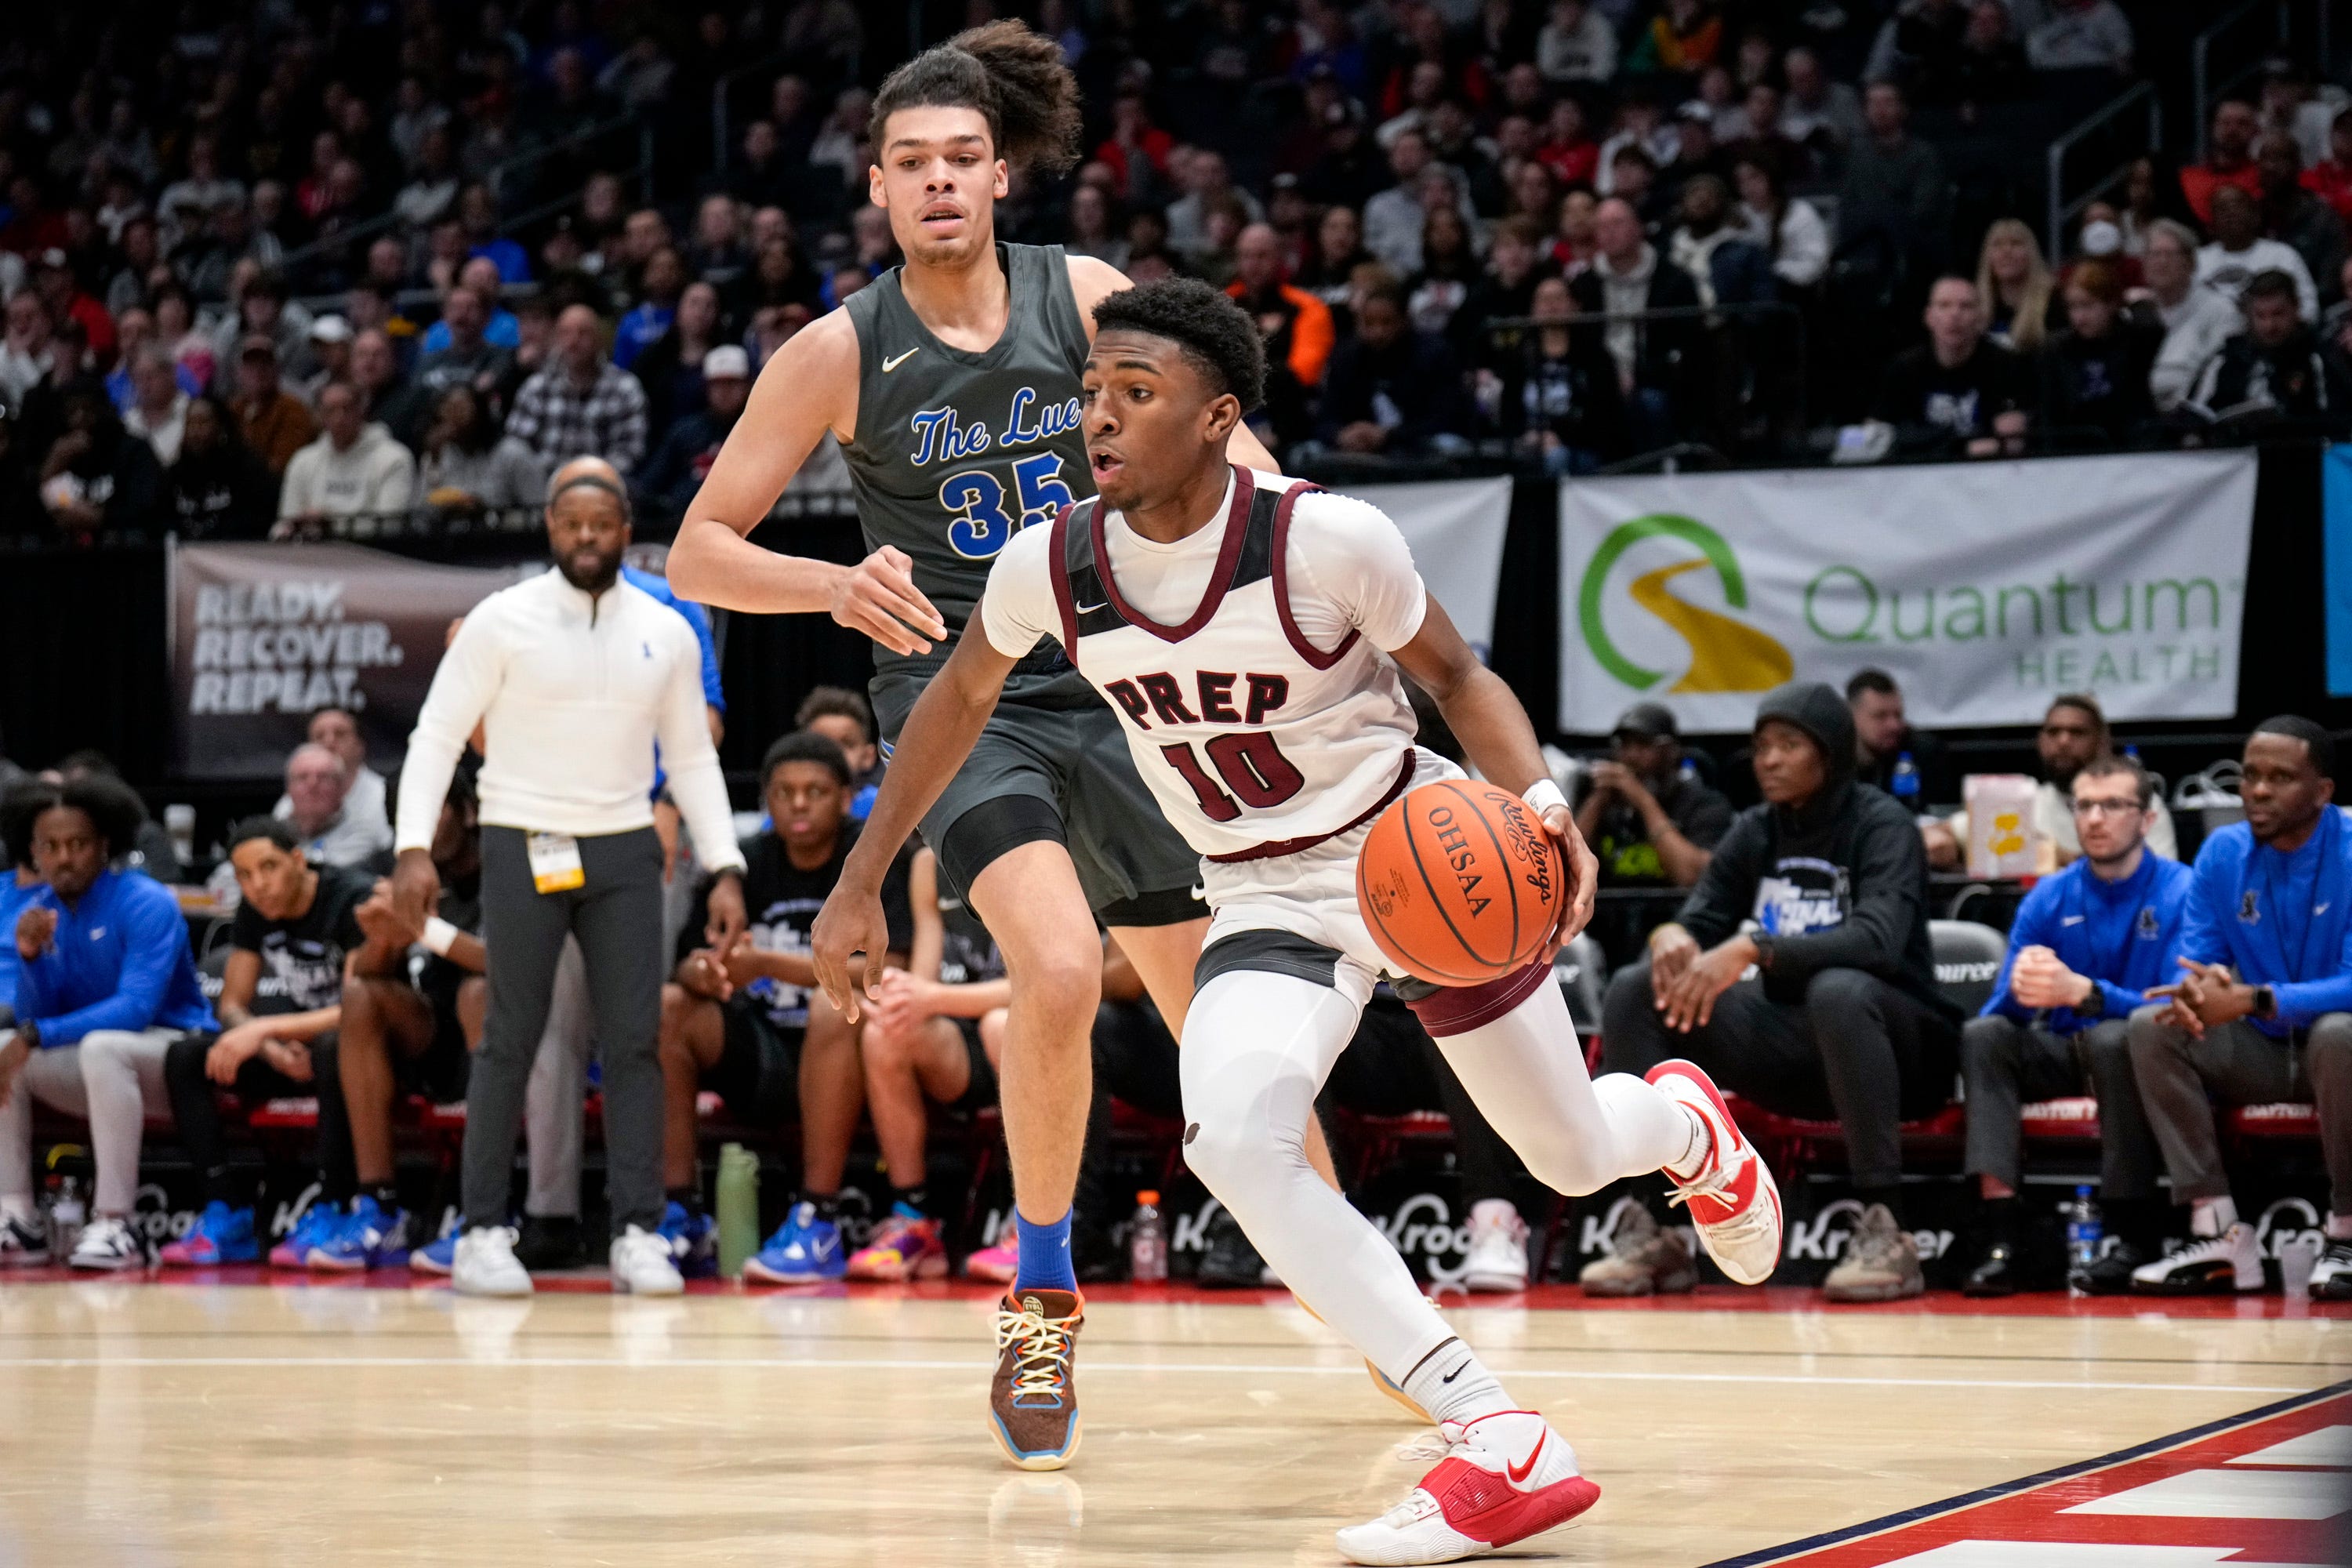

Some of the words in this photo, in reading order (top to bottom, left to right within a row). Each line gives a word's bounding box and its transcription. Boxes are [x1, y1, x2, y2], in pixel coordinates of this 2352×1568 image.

[911, 405, 990, 466] The
[1000, 387, 1082, 447] Lue
[939, 449, 1076, 559] 35
[195, 582, 344, 624] READY.
[1806, 564, 2221, 643] Quantum
[193, 622, 405, 668] RECOVER.
[2016, 644, 2221, 687] HEALTH
[190, 668, 368, 715] REPEAT.
[1104, 670, 1290, 731] PREP
[1159, 731, 1305, 822] 10
[1428, 806, 1493, 919] OHSAA
[1484, 792, 1552, 906] Rawlings
[1788, 1199, 1955, 1260] Krer
